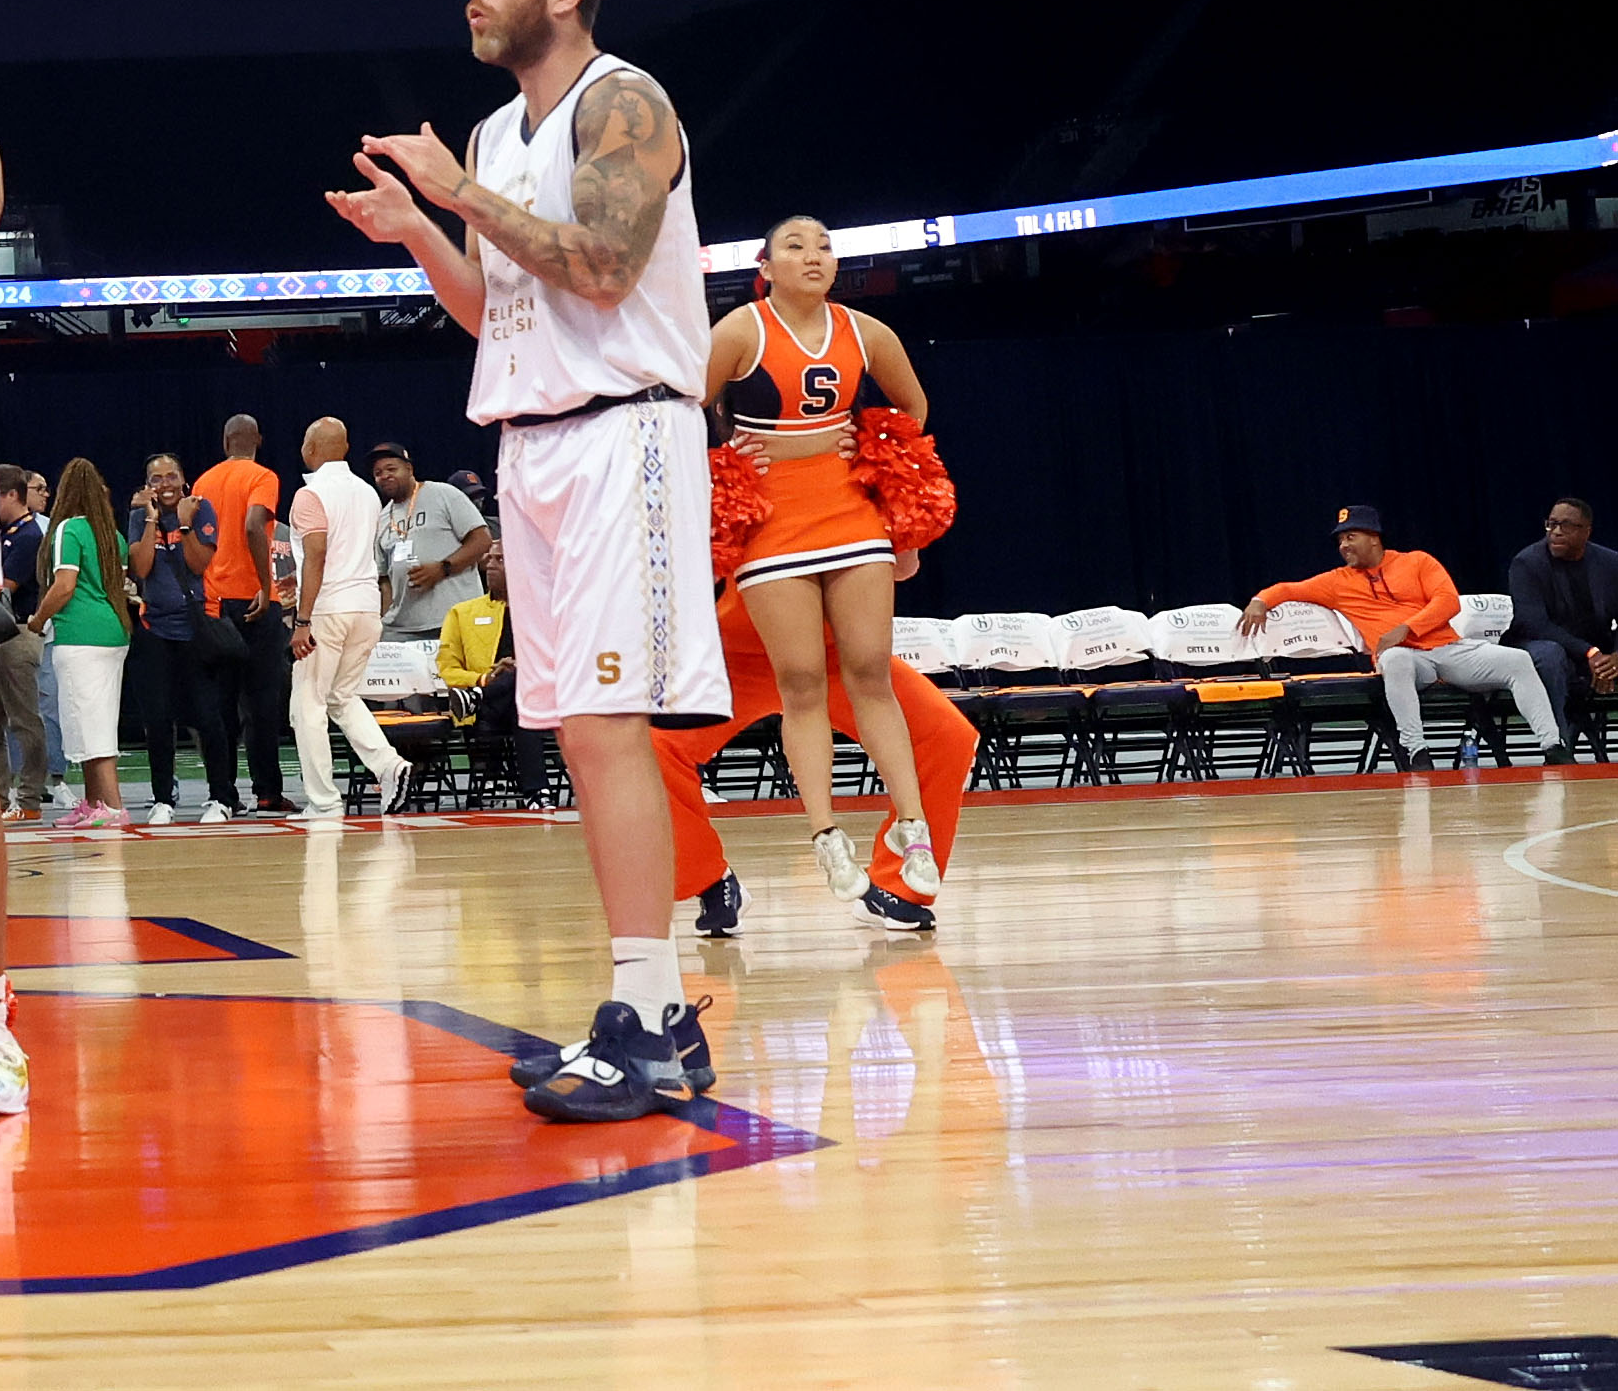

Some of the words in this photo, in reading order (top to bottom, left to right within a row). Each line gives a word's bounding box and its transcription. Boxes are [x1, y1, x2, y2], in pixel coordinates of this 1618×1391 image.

[923, 218, 941, 248] S
[1044, 212, 1055, 233] 4
[799, 364, 840, 417] S
[1192, 619, 1220, 628] Level
[1283, 635, 1303, 647] CRTE
[1085, 646, 1104, 656] CRTE
[1187, 646, 1206, 654] CRTE
[596, 652, 621, 685] S
[367, 678, 385, 687] CRTE
